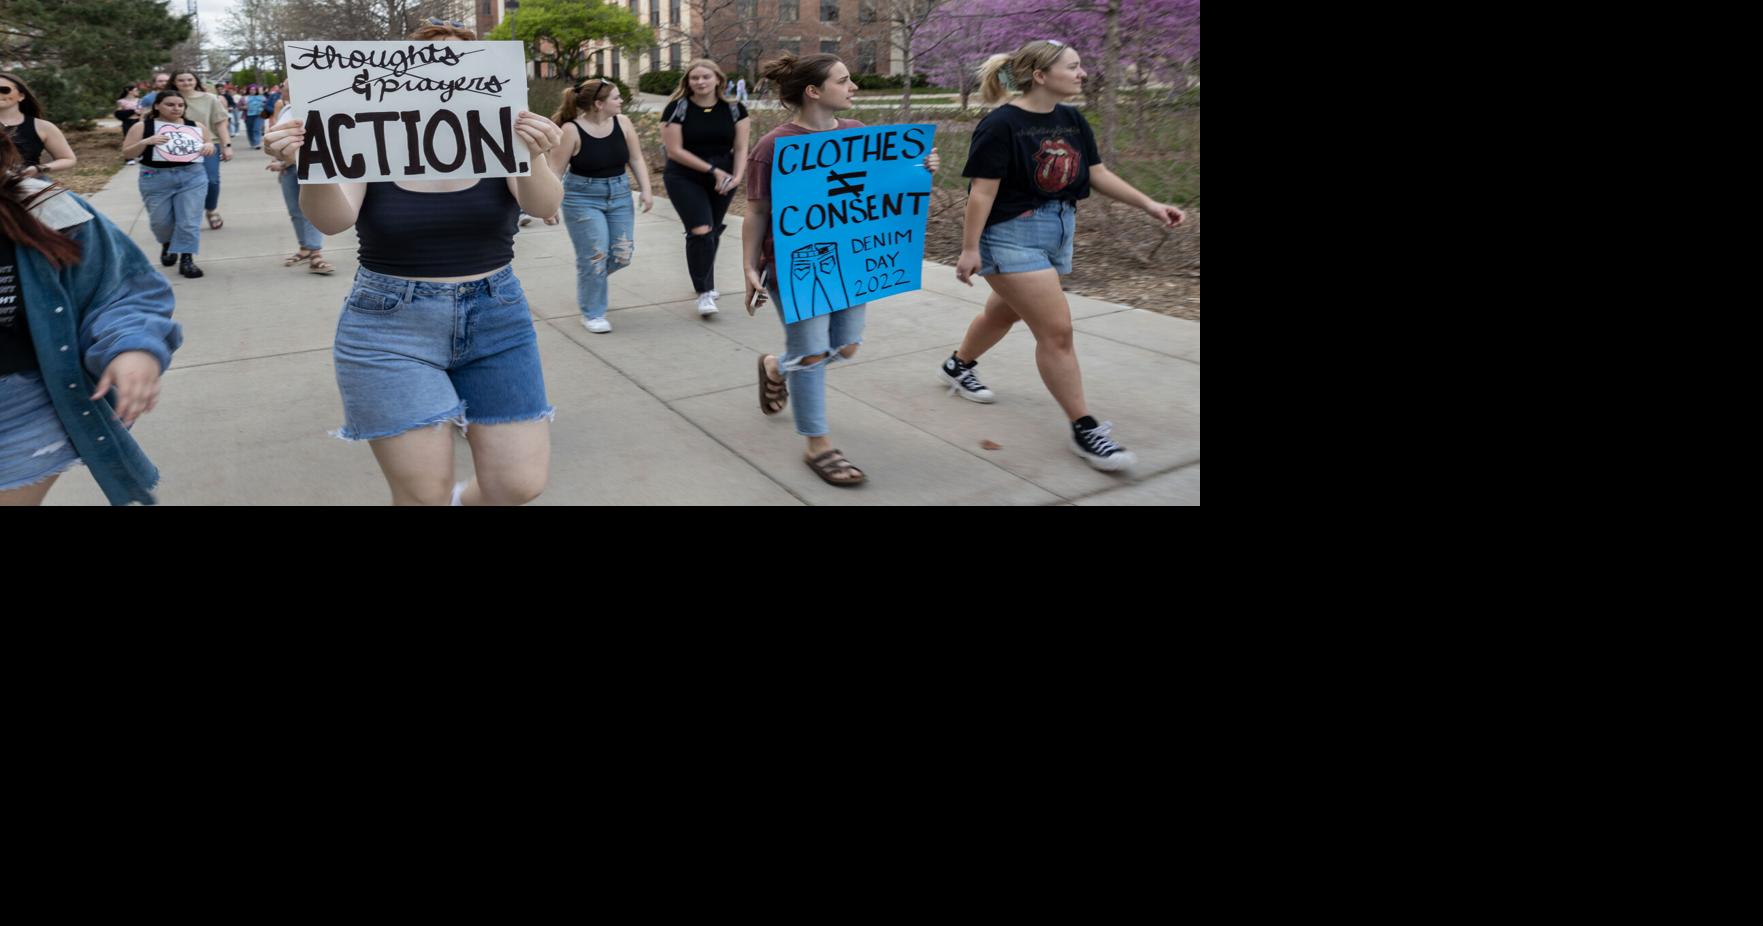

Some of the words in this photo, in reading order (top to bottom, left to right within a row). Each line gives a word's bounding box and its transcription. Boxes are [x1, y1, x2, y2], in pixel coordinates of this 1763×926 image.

[291, 43, 463, 77] thoughts
[373, 74, 503, 102] prayers
[298, 106, 529, 180] ACTION.
[778, 128, 926, 176] CLOTHES
[779, 192, 930, 236] CONSENT
[851, 229, 913, 254] DENIM
[865, 252, 900, 273] DAY
[854, 269, 912, 297] 2022
